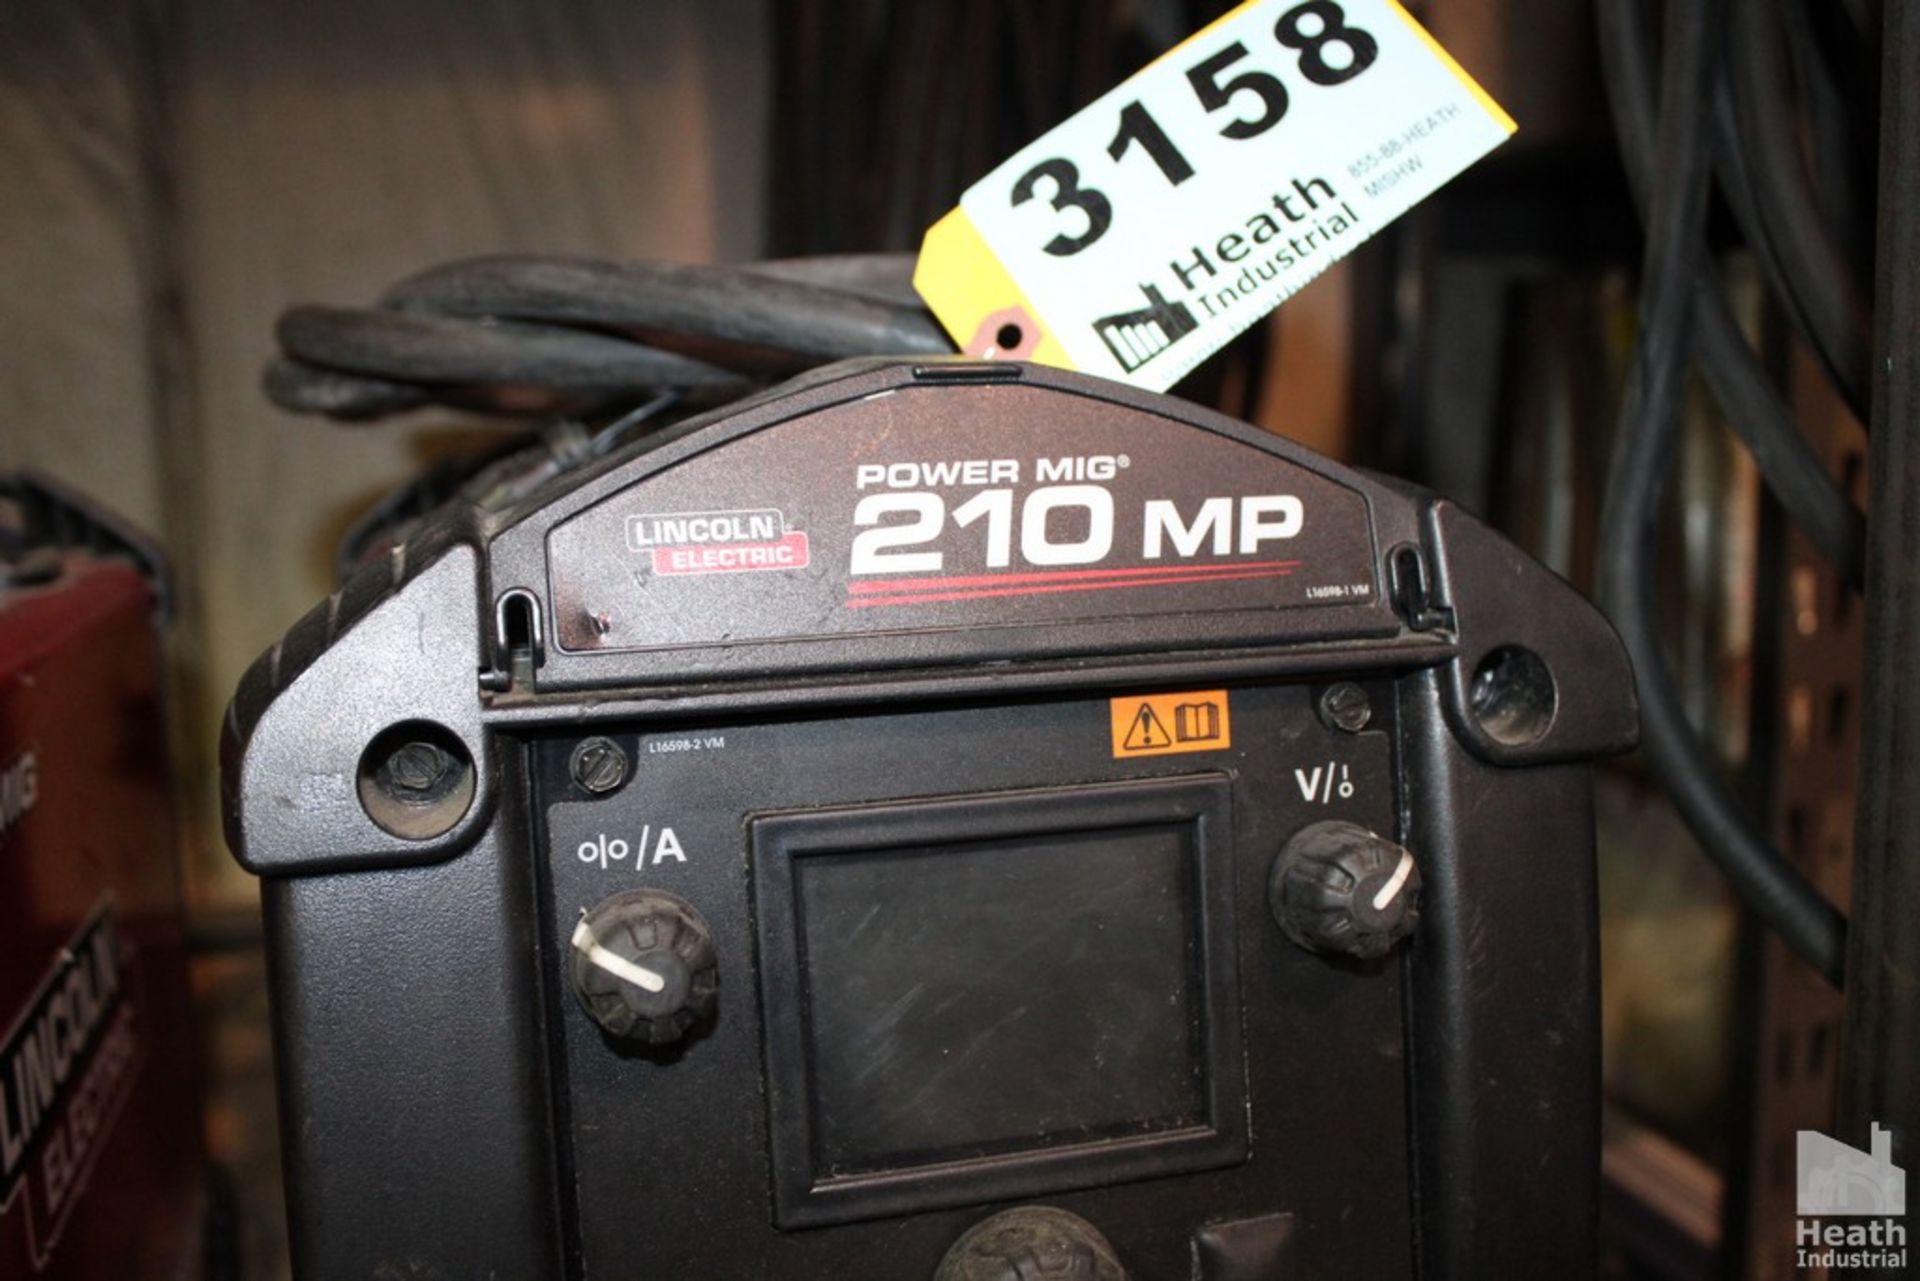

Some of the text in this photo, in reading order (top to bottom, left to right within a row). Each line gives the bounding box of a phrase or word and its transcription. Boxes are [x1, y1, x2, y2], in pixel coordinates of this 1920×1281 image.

[1009, 0, 1380, 258] 3158
[1347, 102, 1461, 179] 855-88-HEATH
[1169, 171, 1337, 291] Heath
[1197, 202, 1359, 319] Industrial
[856, 460, 1019, 489] POWER
[635, 516, 774, 546] LINCOLN
[671, 546, 793, 568] ELECTRIC
[850, 485, 1304, 575] 210 MP
[649, 737, 725, 753] L16598-2 VM
[0, 928, 120, 1175] LINCOLN
